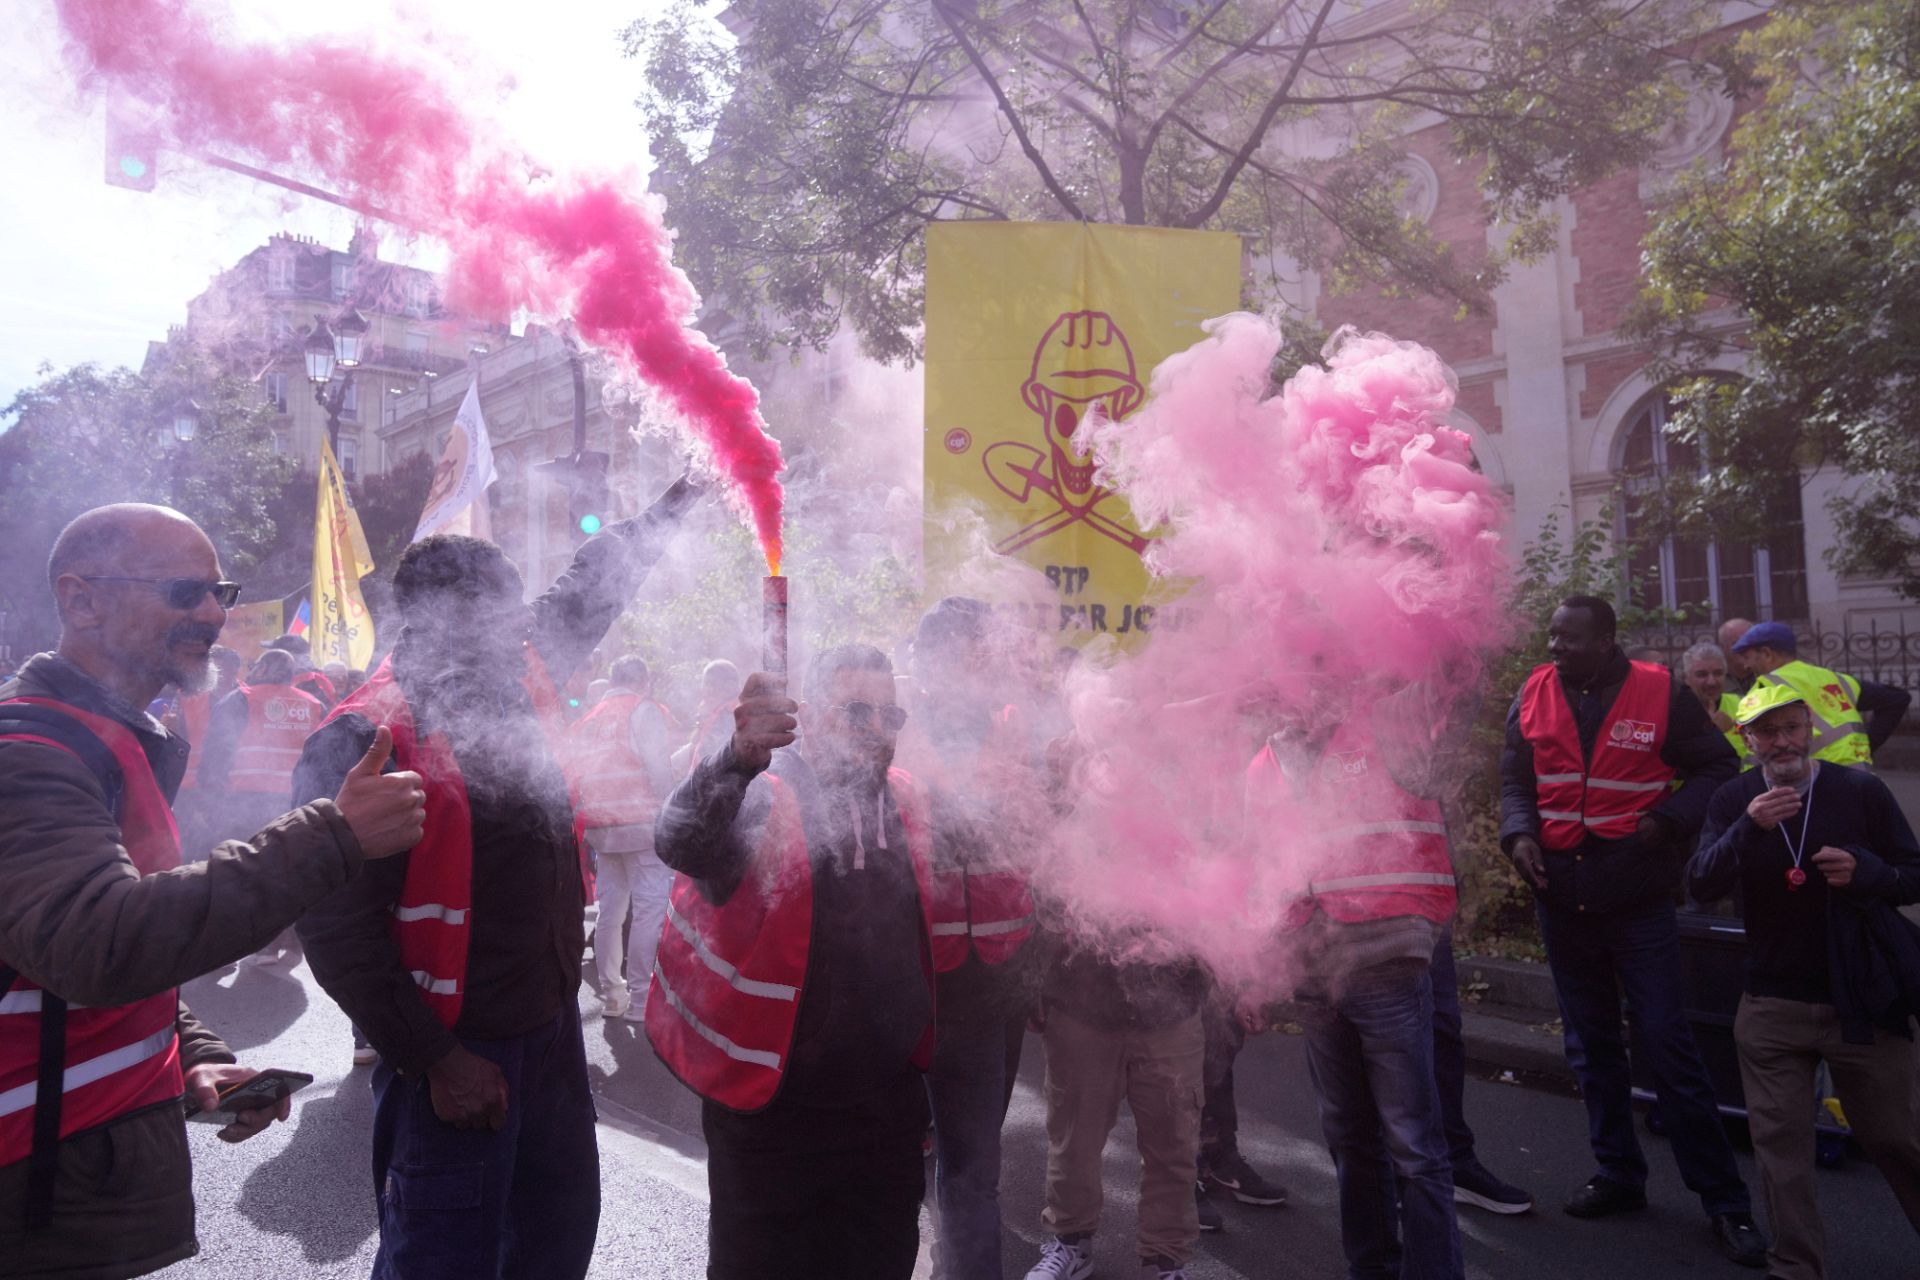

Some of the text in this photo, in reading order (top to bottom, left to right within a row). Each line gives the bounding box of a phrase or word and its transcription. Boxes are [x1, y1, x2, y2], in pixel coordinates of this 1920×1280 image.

[1045, 565, 1089, 596] BTP
[1059, 604, 1107, 633] PAR
[288, 707, 310, 721] cgt
[1633, 730, 1654, 743] cgt
[1344, 759, 1368, 774] cgt
